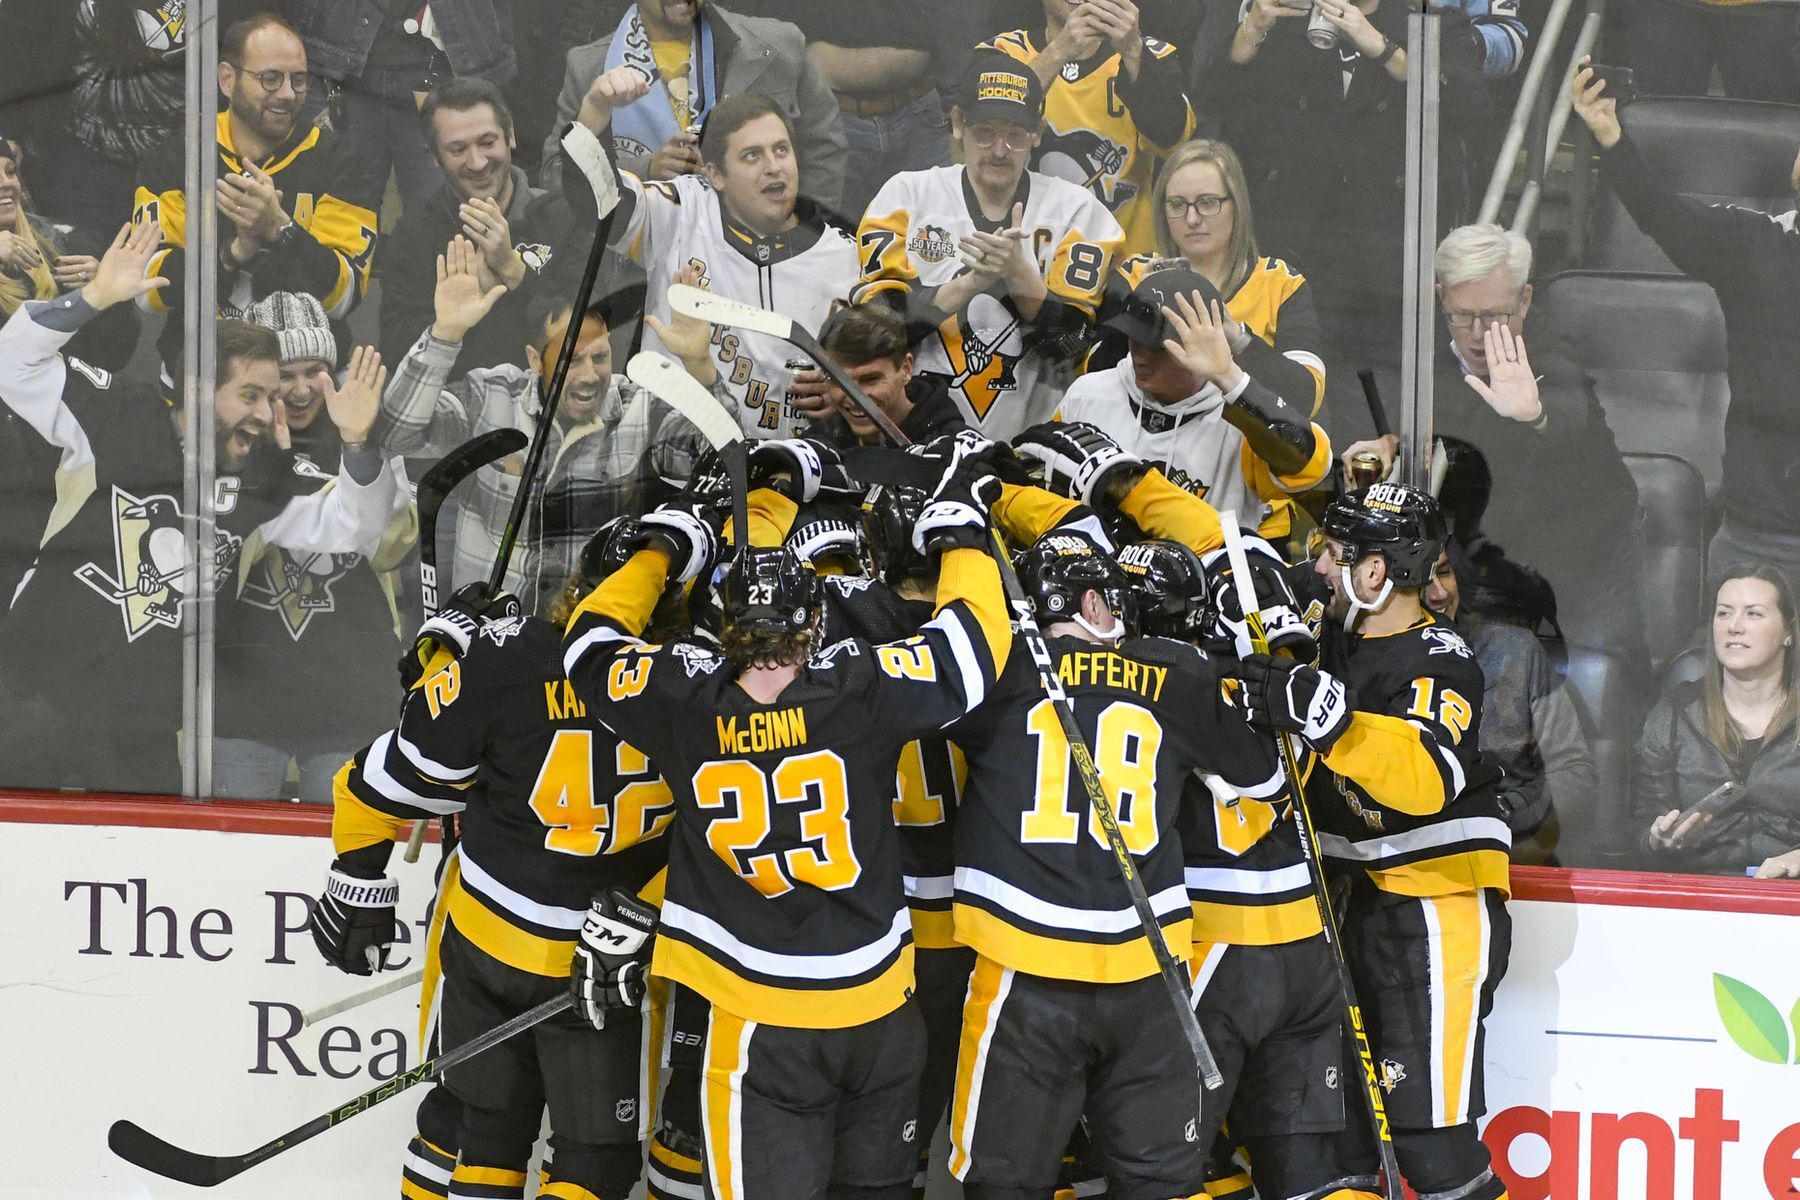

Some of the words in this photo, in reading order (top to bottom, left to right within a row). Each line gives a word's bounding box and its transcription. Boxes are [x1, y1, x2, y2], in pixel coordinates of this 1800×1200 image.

[978, 87, 1026, 102] HOCKEY
[979, 74, 1028, 89] PITTSBURGH
[861, 230, 896, 276] 7
[912, 237, 924, 249] 50
[925, 241, 953, 254] YEARS
[1064, 241, 1105, 292] 8
[693, 475, 718, 494] 77
[1366, 483, 1408, 506] BOLD
[1118, 544, 1154, 568] BOLD
[748, 585, 773, 605] 23
[1010, 599, 1067, 702] CCM
[1040, 651, 1168, 703] AFFERTY
[716, 707, 807, 755] McGINN
[1406, 676, 1473, 747] 12
[527, 729, 678, 858] 42
[1020, 700, 1164, 858] 18
[692, 749, 863, 900] 23
[64, 878, 234, 962] The
[617, 905, 653, 927] PENGUINS
[672, 1030, 704, 1048] BA
[328, 1059, 435, 1129] CCM
[1349, 1005, 1393, 1142] NEXUS
